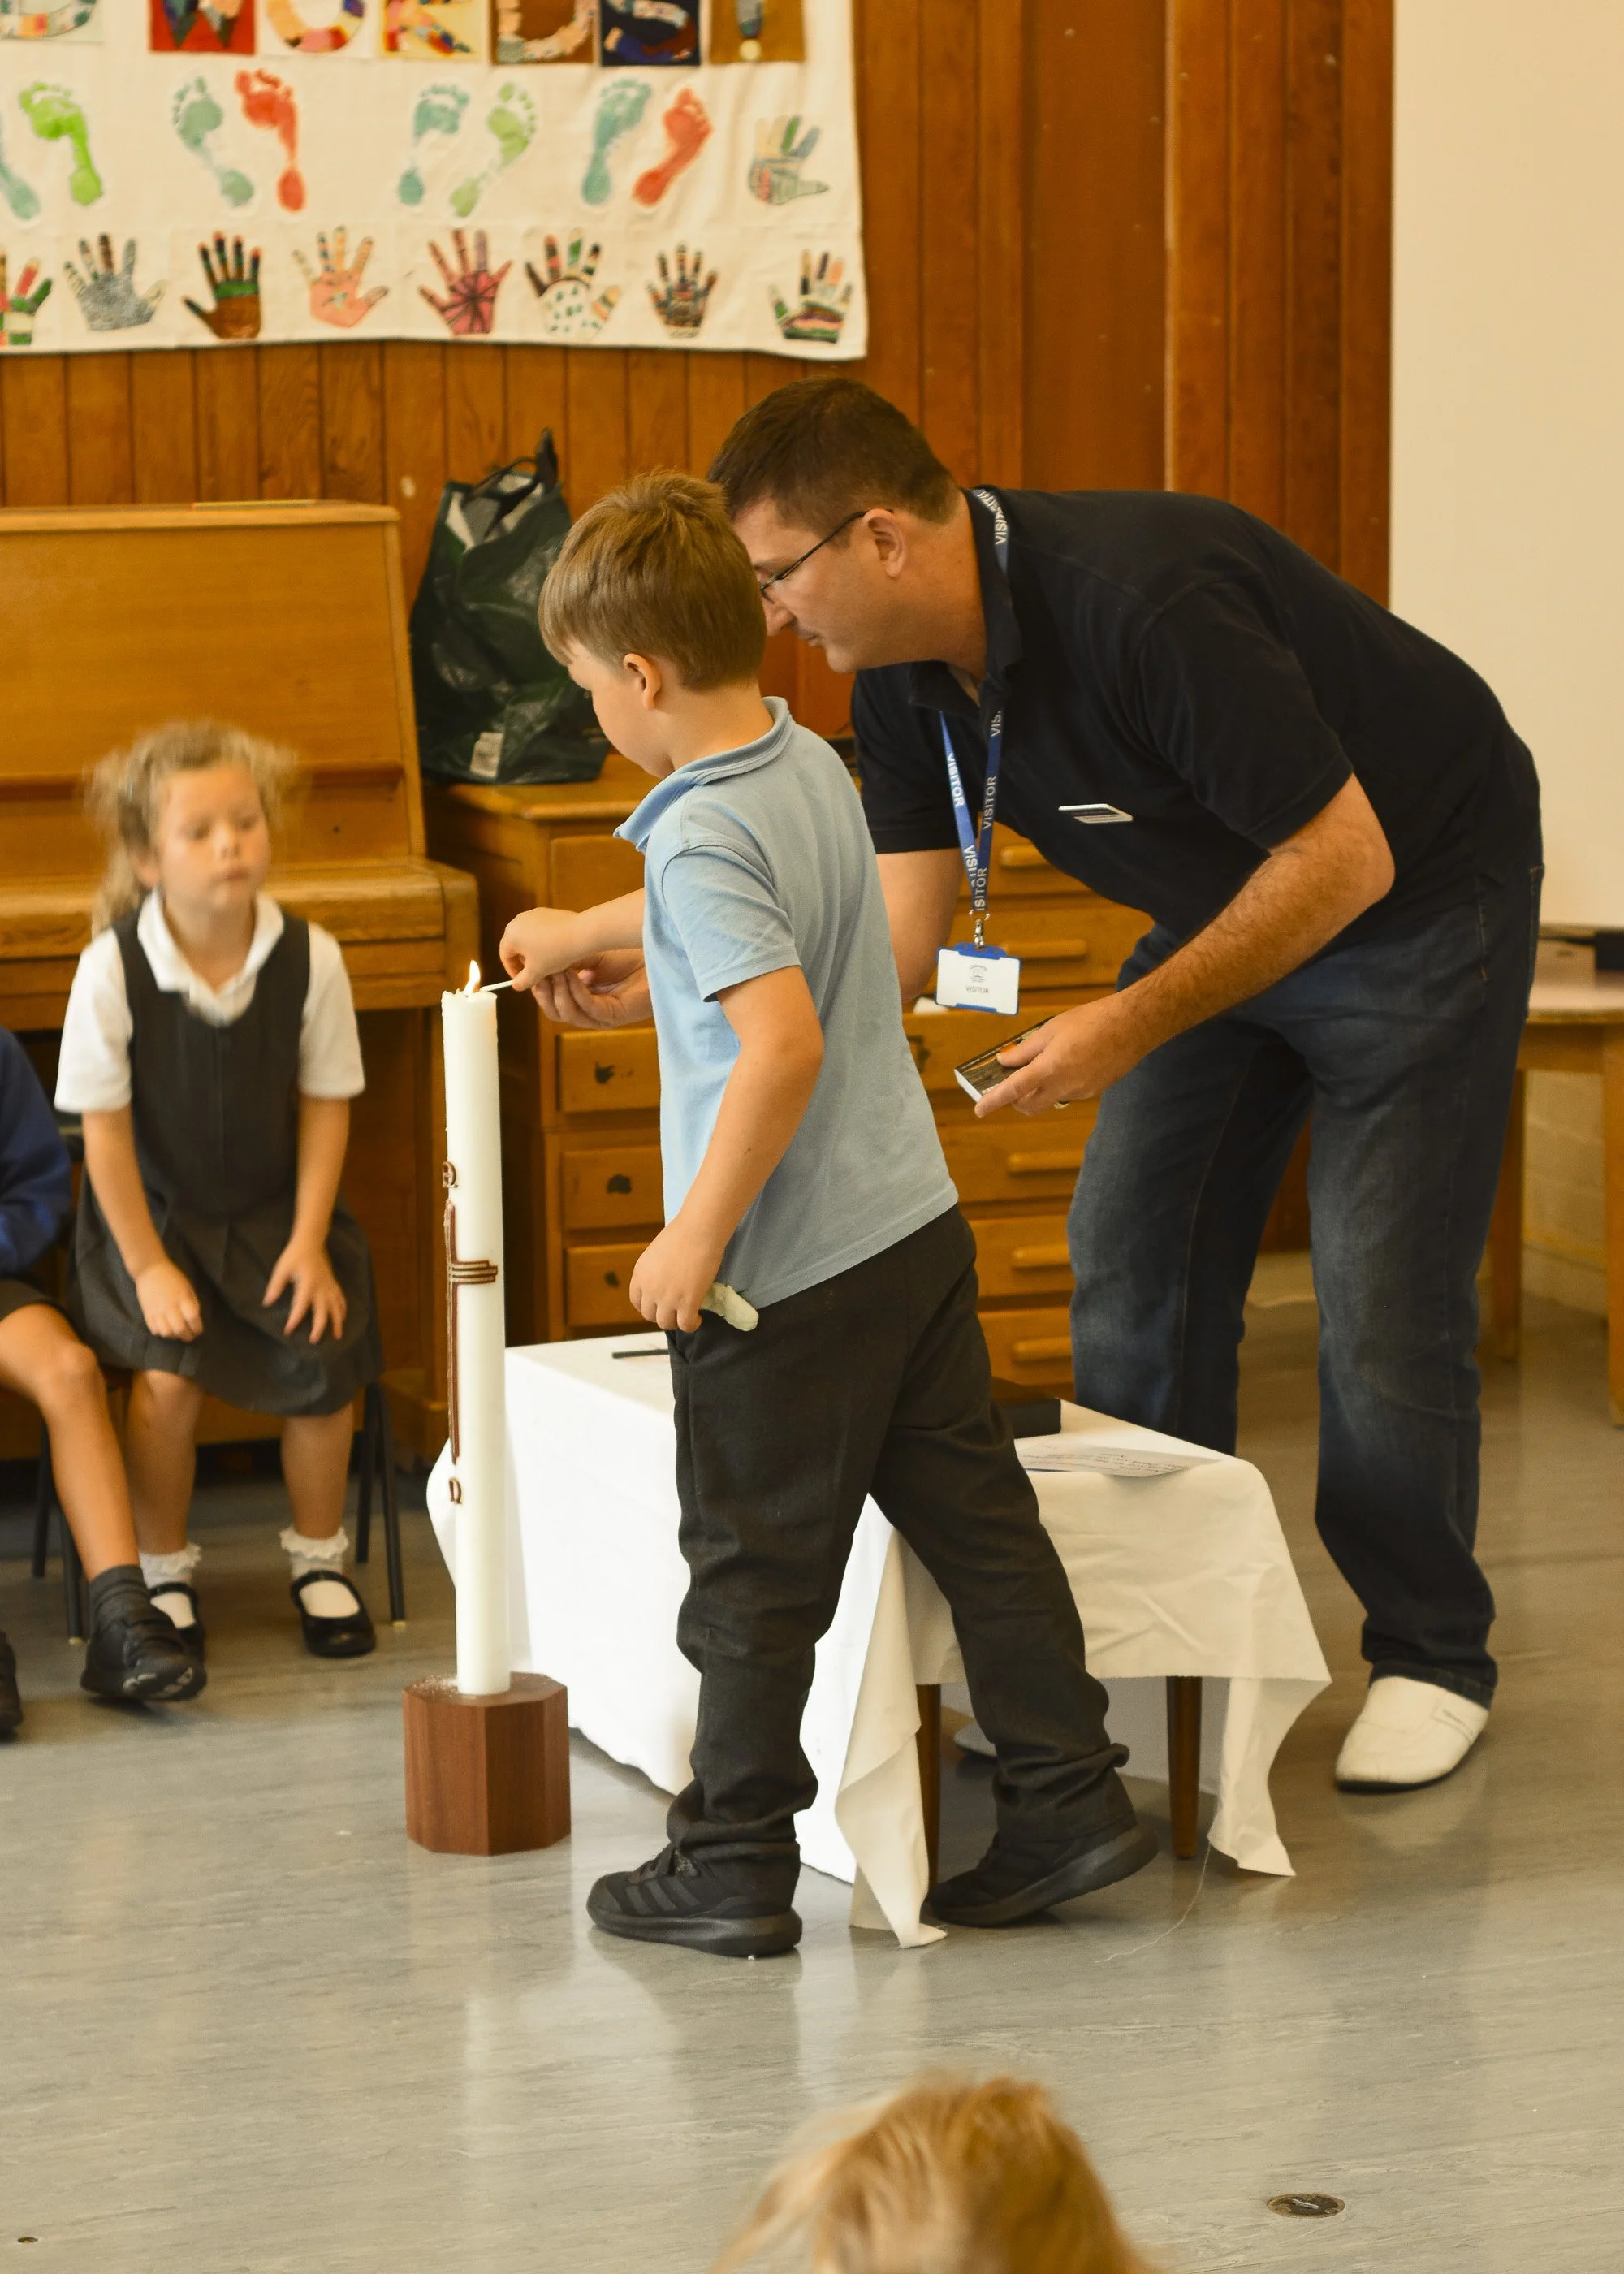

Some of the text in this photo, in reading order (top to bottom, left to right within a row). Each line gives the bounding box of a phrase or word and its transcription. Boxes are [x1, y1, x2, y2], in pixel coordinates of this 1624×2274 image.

[990, 710, 1002, 737] VIS
[946, 751, 965, 808] VISITOR
[982, 775, 997, 830] VISITOR
[974, 867, 987, 910] ISITOR
